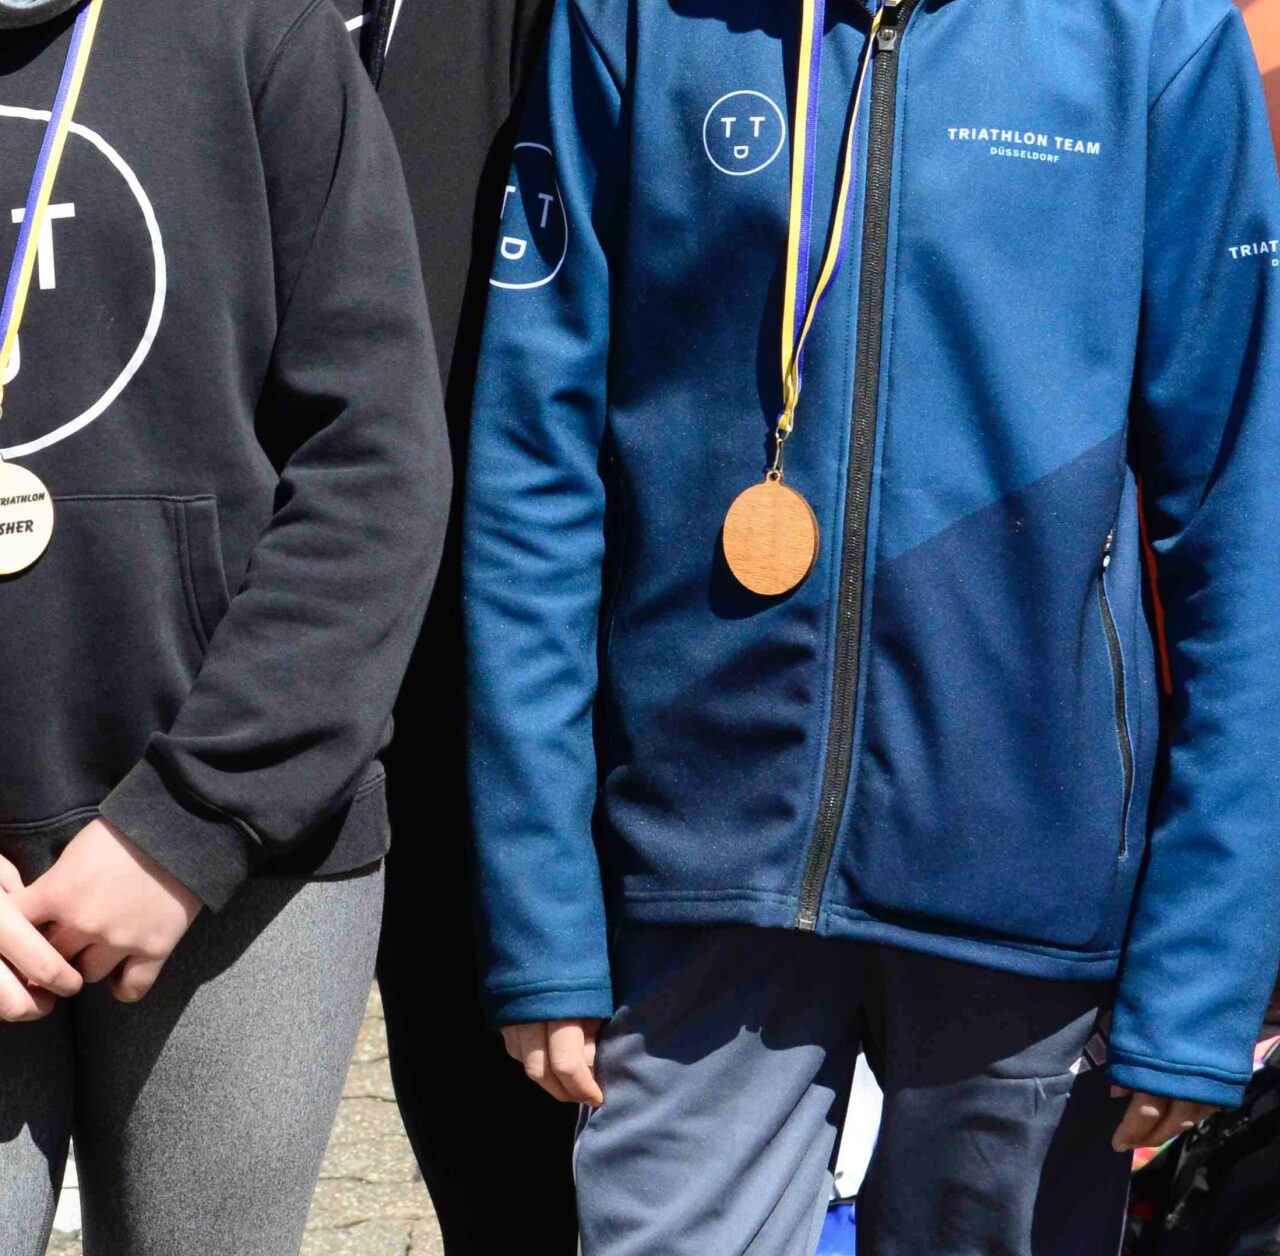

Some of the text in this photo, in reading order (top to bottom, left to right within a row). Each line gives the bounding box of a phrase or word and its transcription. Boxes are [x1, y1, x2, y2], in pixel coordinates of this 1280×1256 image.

[947, 128, 1101, 155] TRIATHLON TEAM
[990, 146, 1060, 163] DÜSSELDORF
